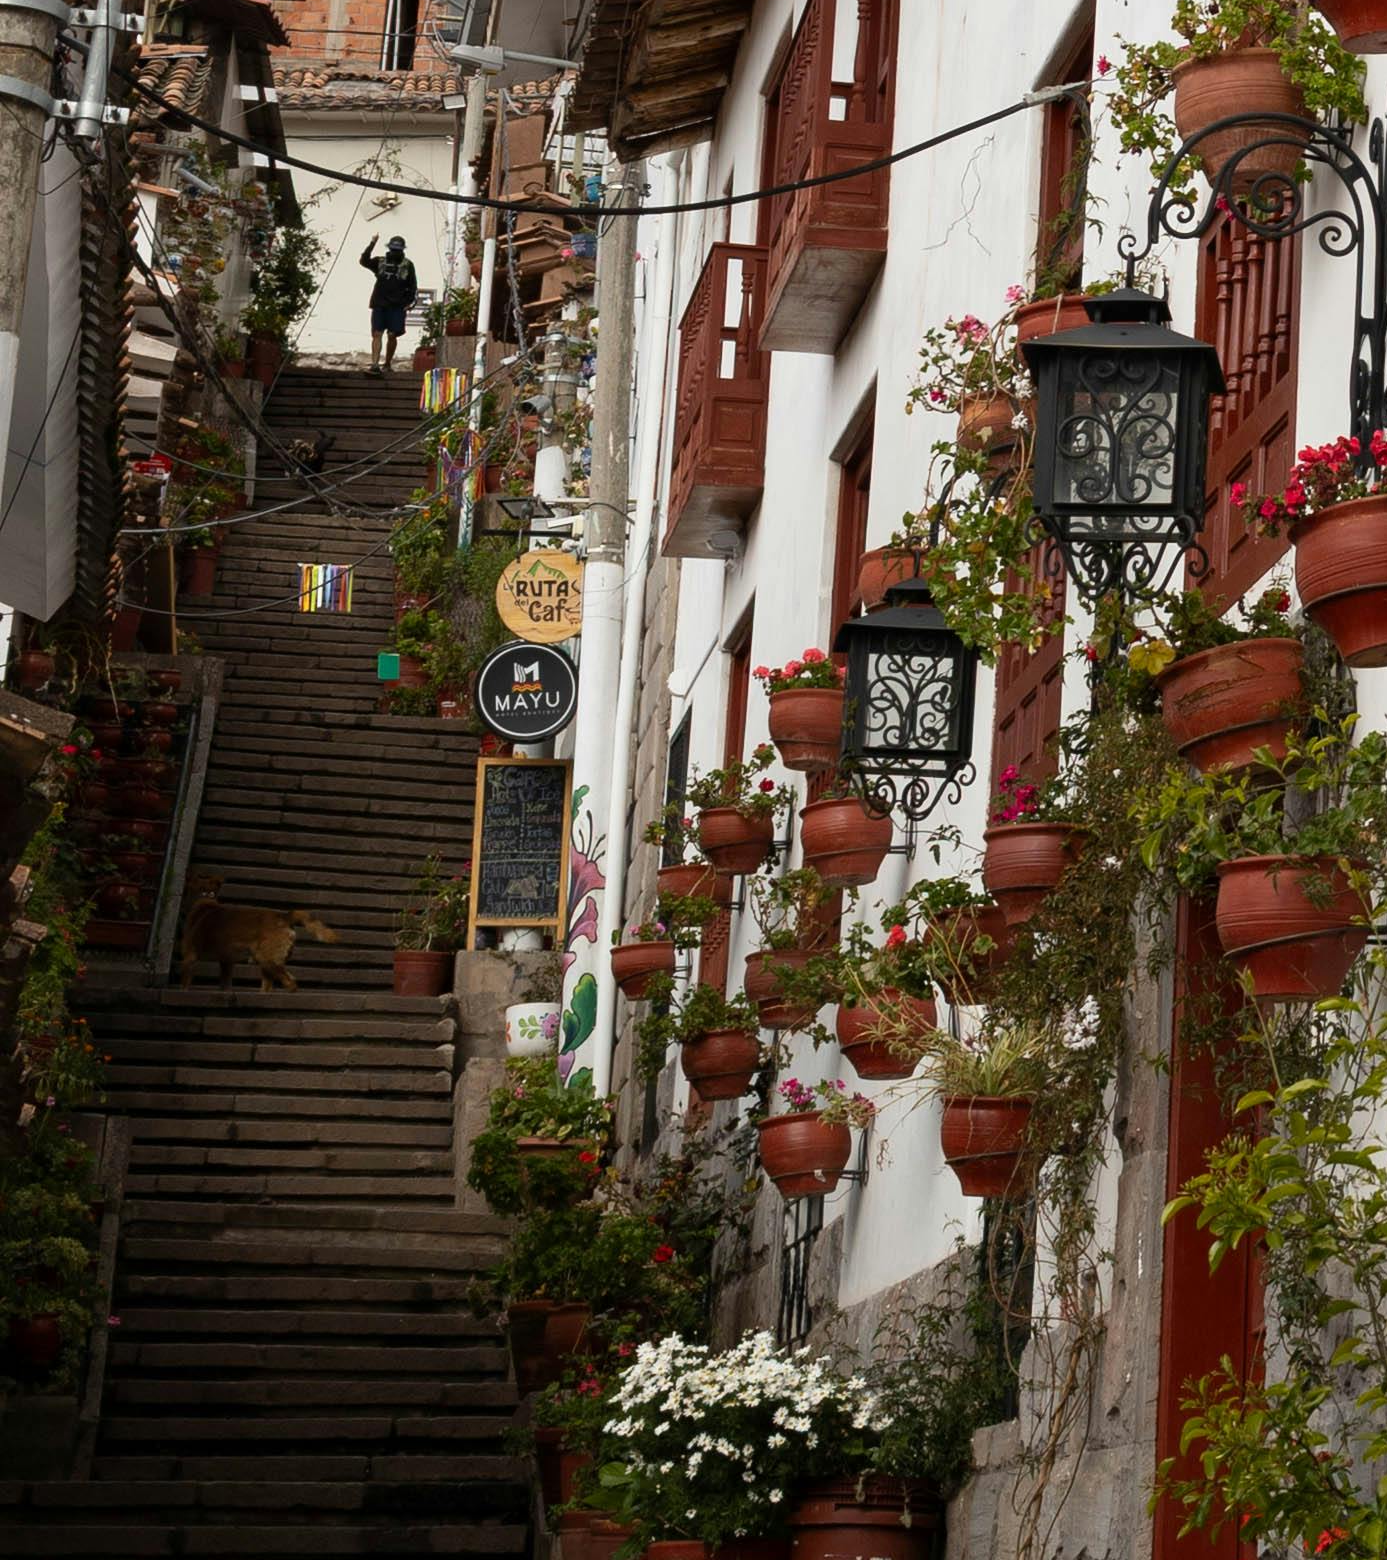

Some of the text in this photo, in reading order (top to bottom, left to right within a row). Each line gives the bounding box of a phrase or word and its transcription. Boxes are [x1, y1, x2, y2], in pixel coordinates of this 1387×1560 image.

[516, 580, 569, 597] RUTA
[514, 598, 568, 623] del Caf
[495, 691, 560, 711] MAYU
